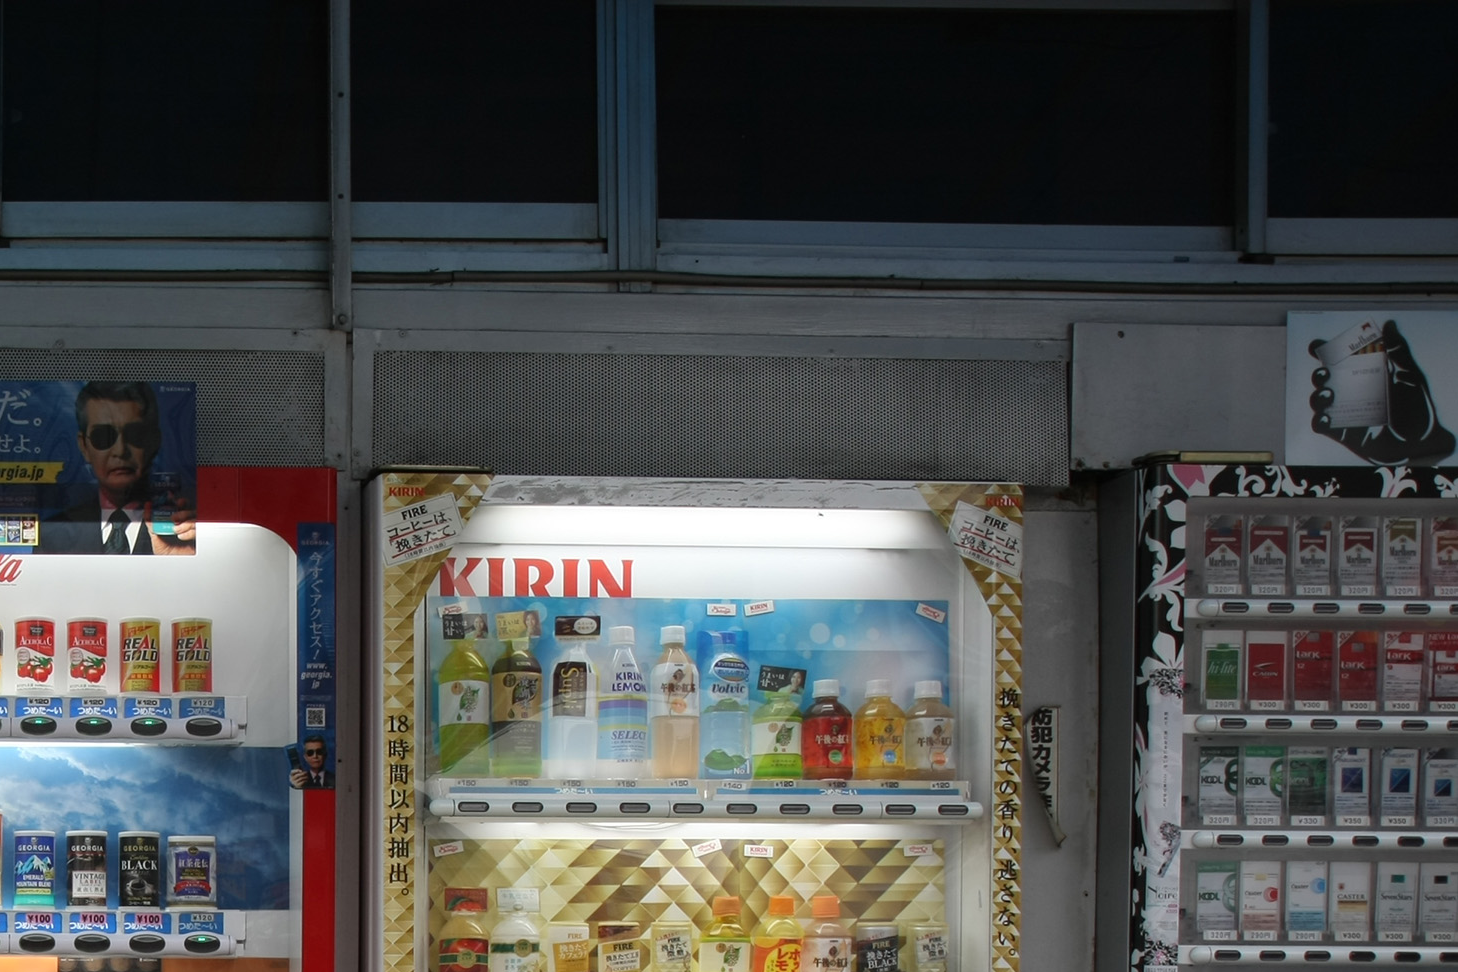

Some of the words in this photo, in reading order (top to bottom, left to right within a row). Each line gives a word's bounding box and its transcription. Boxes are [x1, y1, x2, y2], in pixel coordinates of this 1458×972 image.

[388, 486, 426, 497] KIRIN
[401, 504, 428, 521] FIRE
[983, 515, 1009, 532] FIRE
[440, 557, 634, 598] KIRIN
[123, 634, 157, 651] REAL
[176, 634, 209, 651] REAL
[123, 650, 158, 663] GOLD
[175, 650, 210, 663] GOLD
[387, 714, 409, 896] 18時間以内抽出。
